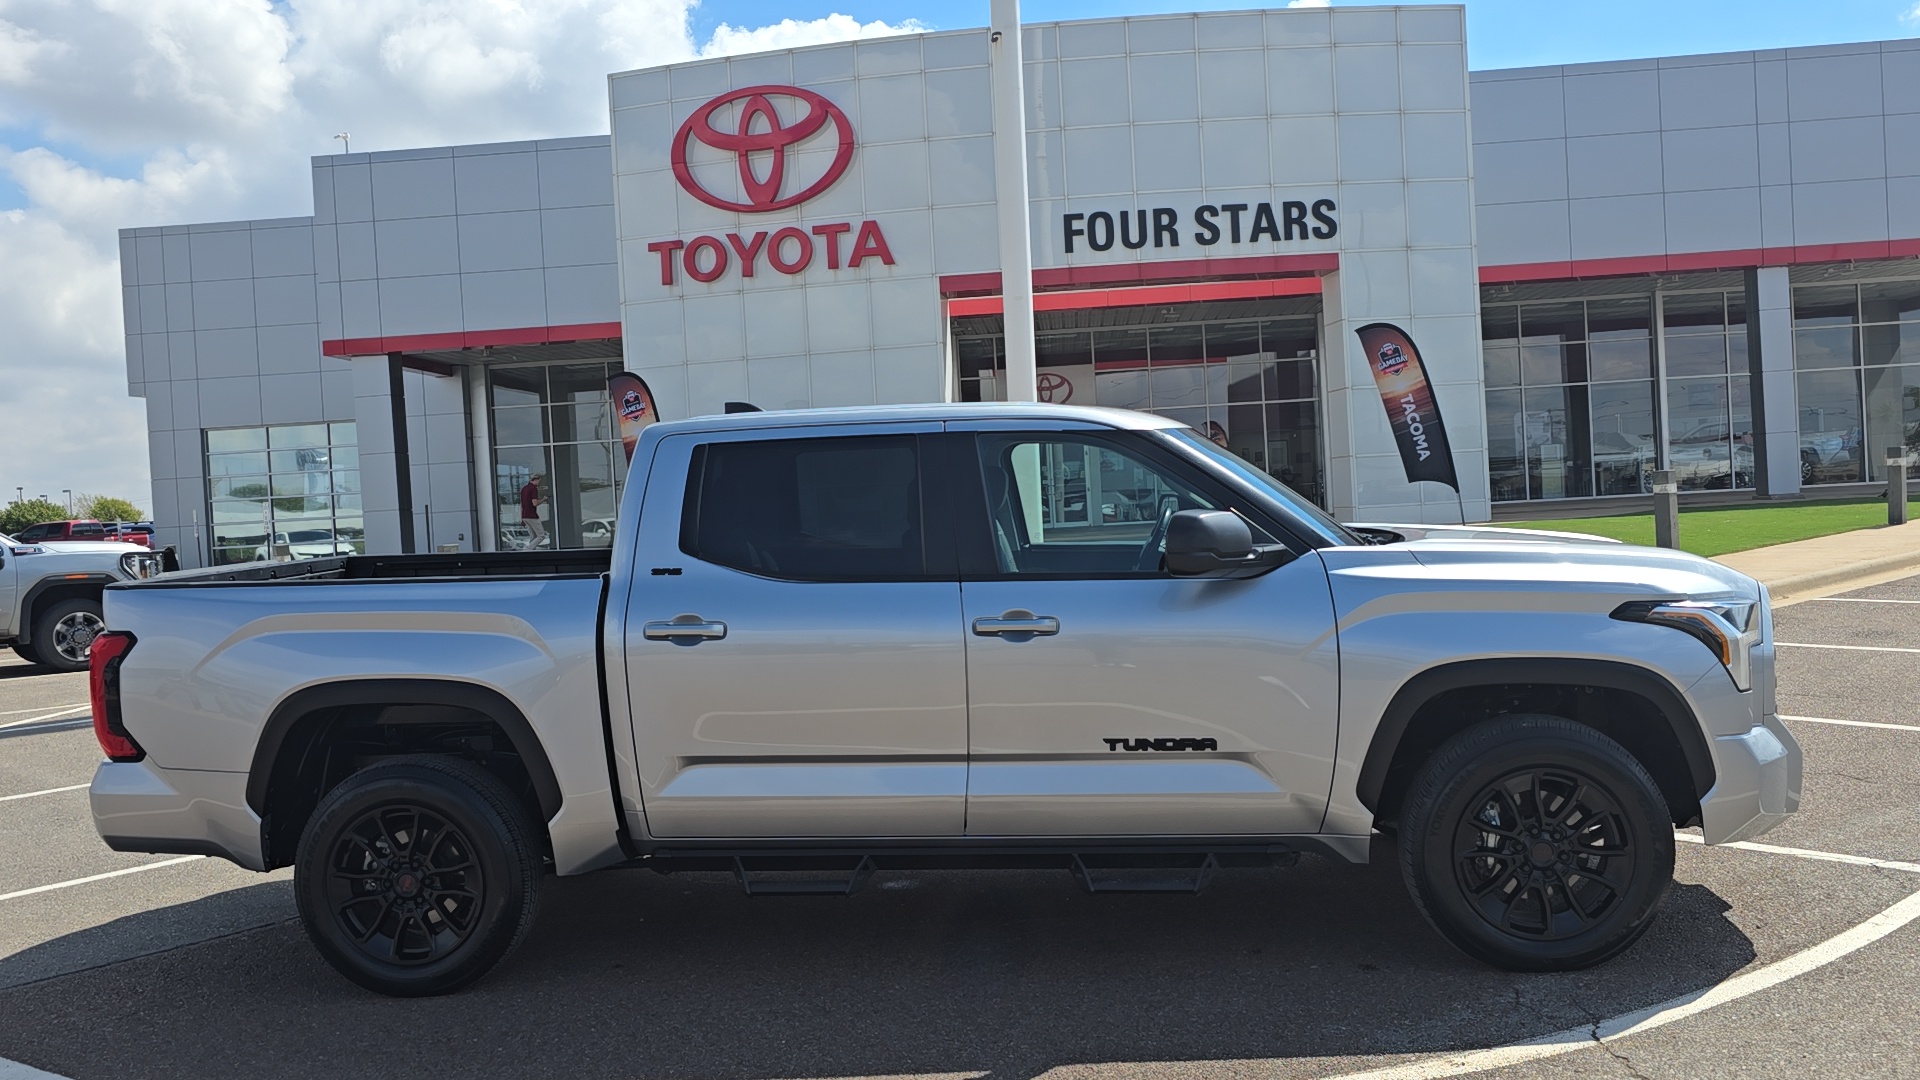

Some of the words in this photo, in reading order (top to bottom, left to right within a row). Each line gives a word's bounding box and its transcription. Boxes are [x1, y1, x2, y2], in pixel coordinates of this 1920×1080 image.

[648, 220, 895, 285] TOYOTA
[1063, 208, 1180, 253] FOUR
[1194, 199, 1338, 246] STARS
[1378, 354, 1408, 371] GAMEDAY
[1400, 393, 1431, 462] TACOMA
[1102, 738, 1218, 752] TUNDRA
